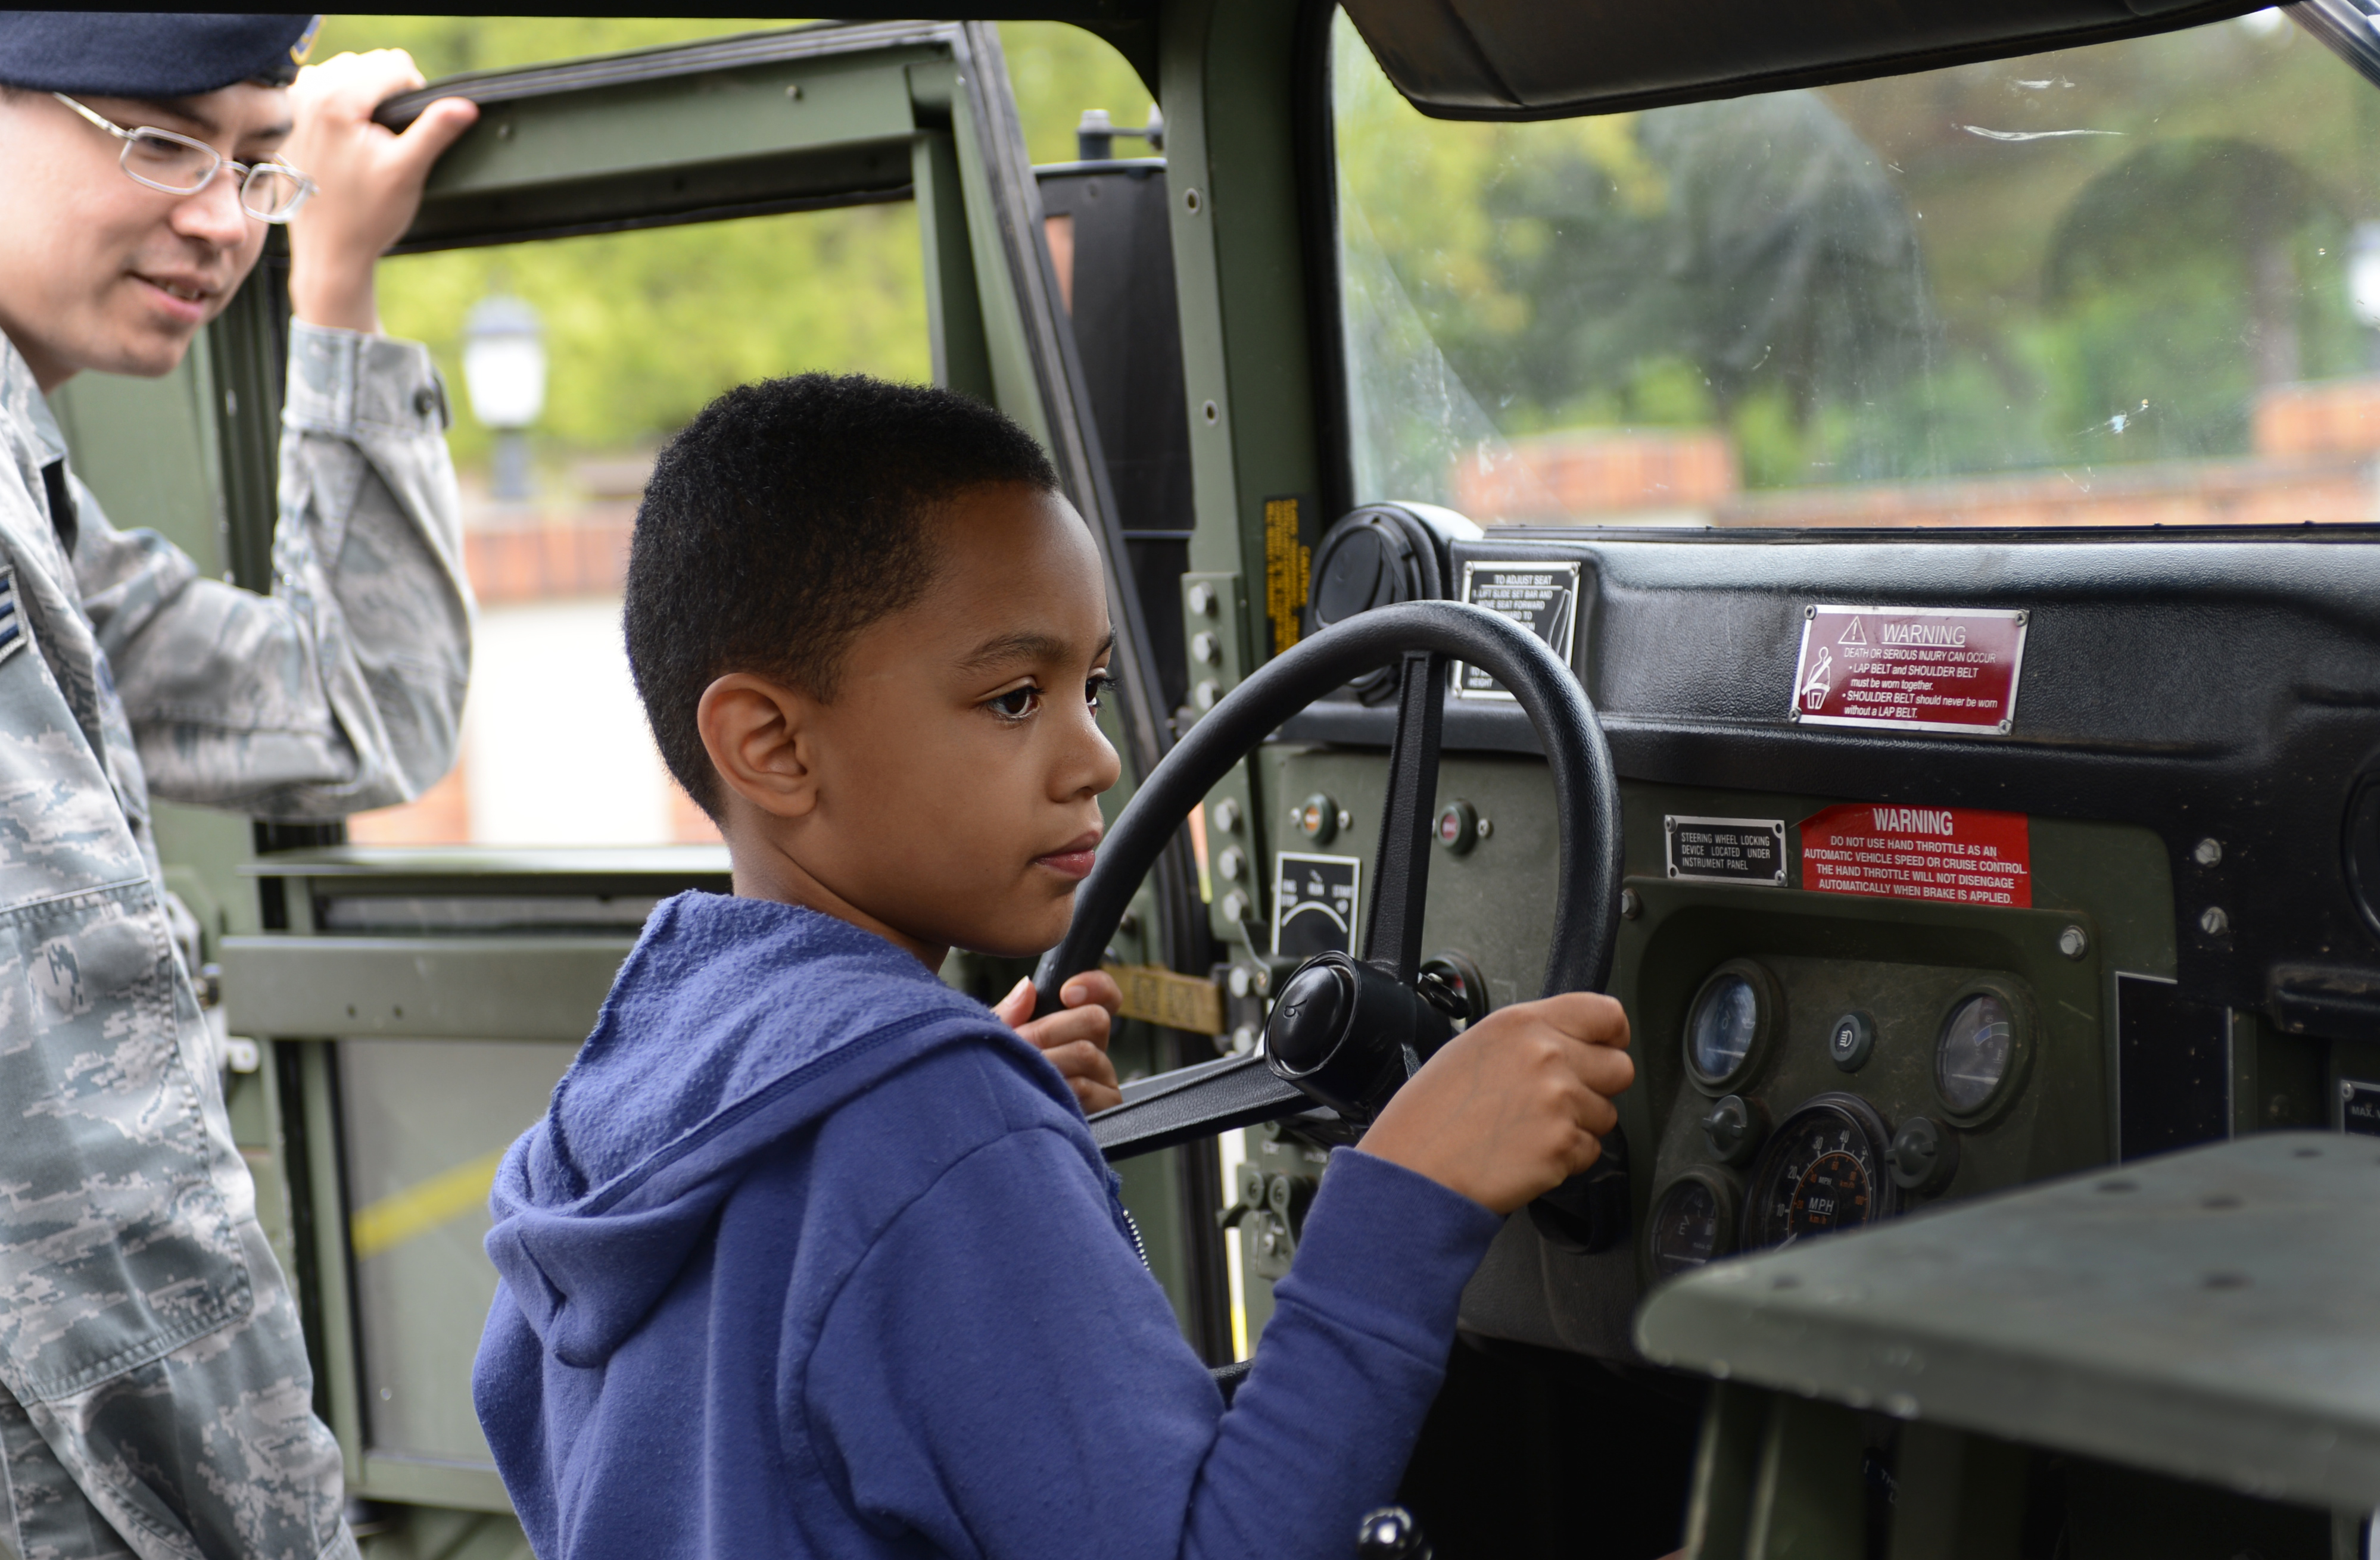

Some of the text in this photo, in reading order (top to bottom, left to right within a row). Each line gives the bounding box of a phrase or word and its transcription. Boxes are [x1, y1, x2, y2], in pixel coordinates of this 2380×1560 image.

[1494, 575, 1553, 585] TO ADJUST SEAT
[1493, 589, 1510, 600] SLIDE
[1512, 590, 1524, 600] SET
[1525, 590, 1538, 600] BAR
[1538, 590, 1553, 600] AND
[1496, 600, 1513, 610] SEAT
[1514, 600, 1545, 611] FORWARD
[1884, 623, 1965, 645] WARNING
[1844, 648, 1996, 663] DEATH OR SERIOUS INJURY CAN OCCUR
[1854, 663, 1979, 678] LAP BELT and SHOULDER BELT
[1851, 678, 1934, 691] must be worn together.
[1847, 691, 1998, 709] SHOULDER BELT should never be worn
[1844, 705, 1871, 716] without
[1879, 707, 1895, 717] LAP
[1896, 707, 1917, 718] BELT.
[1873, 808, 1953, 835] WARNING
[1681, 832, 1770, 846] STEERING WHEEL LOCKING
[1682, 845, 1770, 859] DEVICE LOCATED UNDER
[1831, 836, 1996, 857] DO NOT USE HAND THROTTLE AS AN
[1683, 857, 1748, 870] INSTRUMENT PANEL
[1804, 848, 2027, 874] AUTOMATIC VEHICLE SPEED OR CRUISE CONTROL.
[1817, 864, 2014, 888] THE HAND THROTTLE WILL NOT DISENGAGE
[1819, 879, 2013, 904] AUTOMATICALLY WHEN BRAKE IS APPLIED.
[2351, 1106, 2375, 1118] MAX.
[1813, 1136, 1823, 1150] 30
[1840, 1130, 1850, 1143] 40
[1787, 1165, 1798, 1180] 20
[1818, 1177, 1832, 1185] MPH
[1777, 1203, 1785, 1217] 10
[1809, 1197, 1834, 1212] MPH
[1678, 1222, 1687, 1235] E
